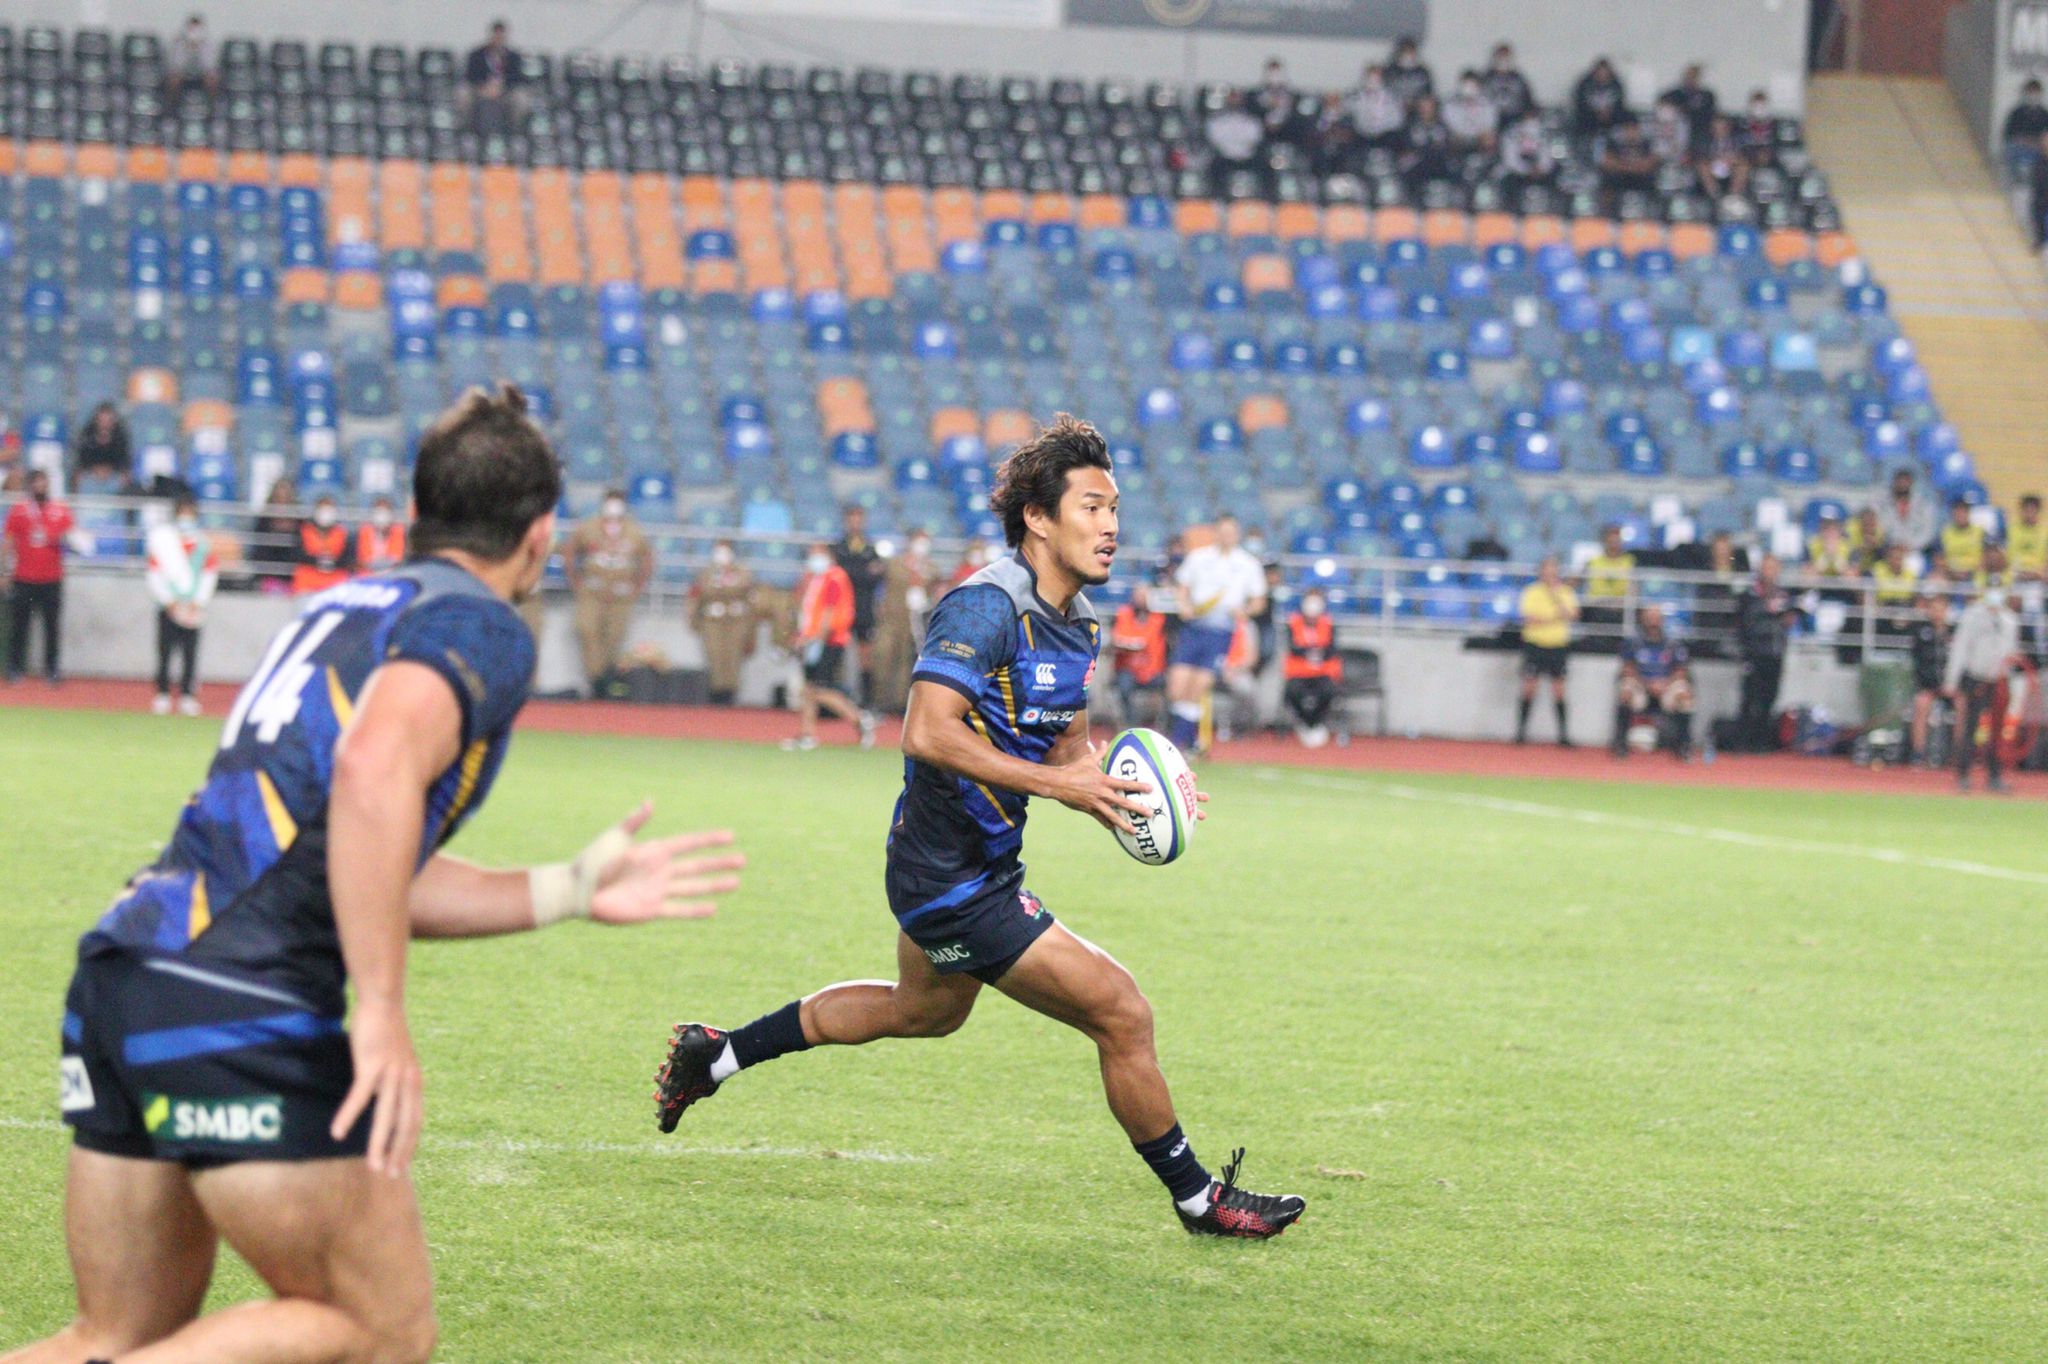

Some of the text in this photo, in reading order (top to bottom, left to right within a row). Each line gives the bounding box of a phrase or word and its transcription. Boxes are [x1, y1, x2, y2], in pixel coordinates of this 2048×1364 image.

[219, 611, 346, 750] 14
[1120, 759, 1161, 859] GLBERT
[174, 1102, 281, 1140] SMBC
